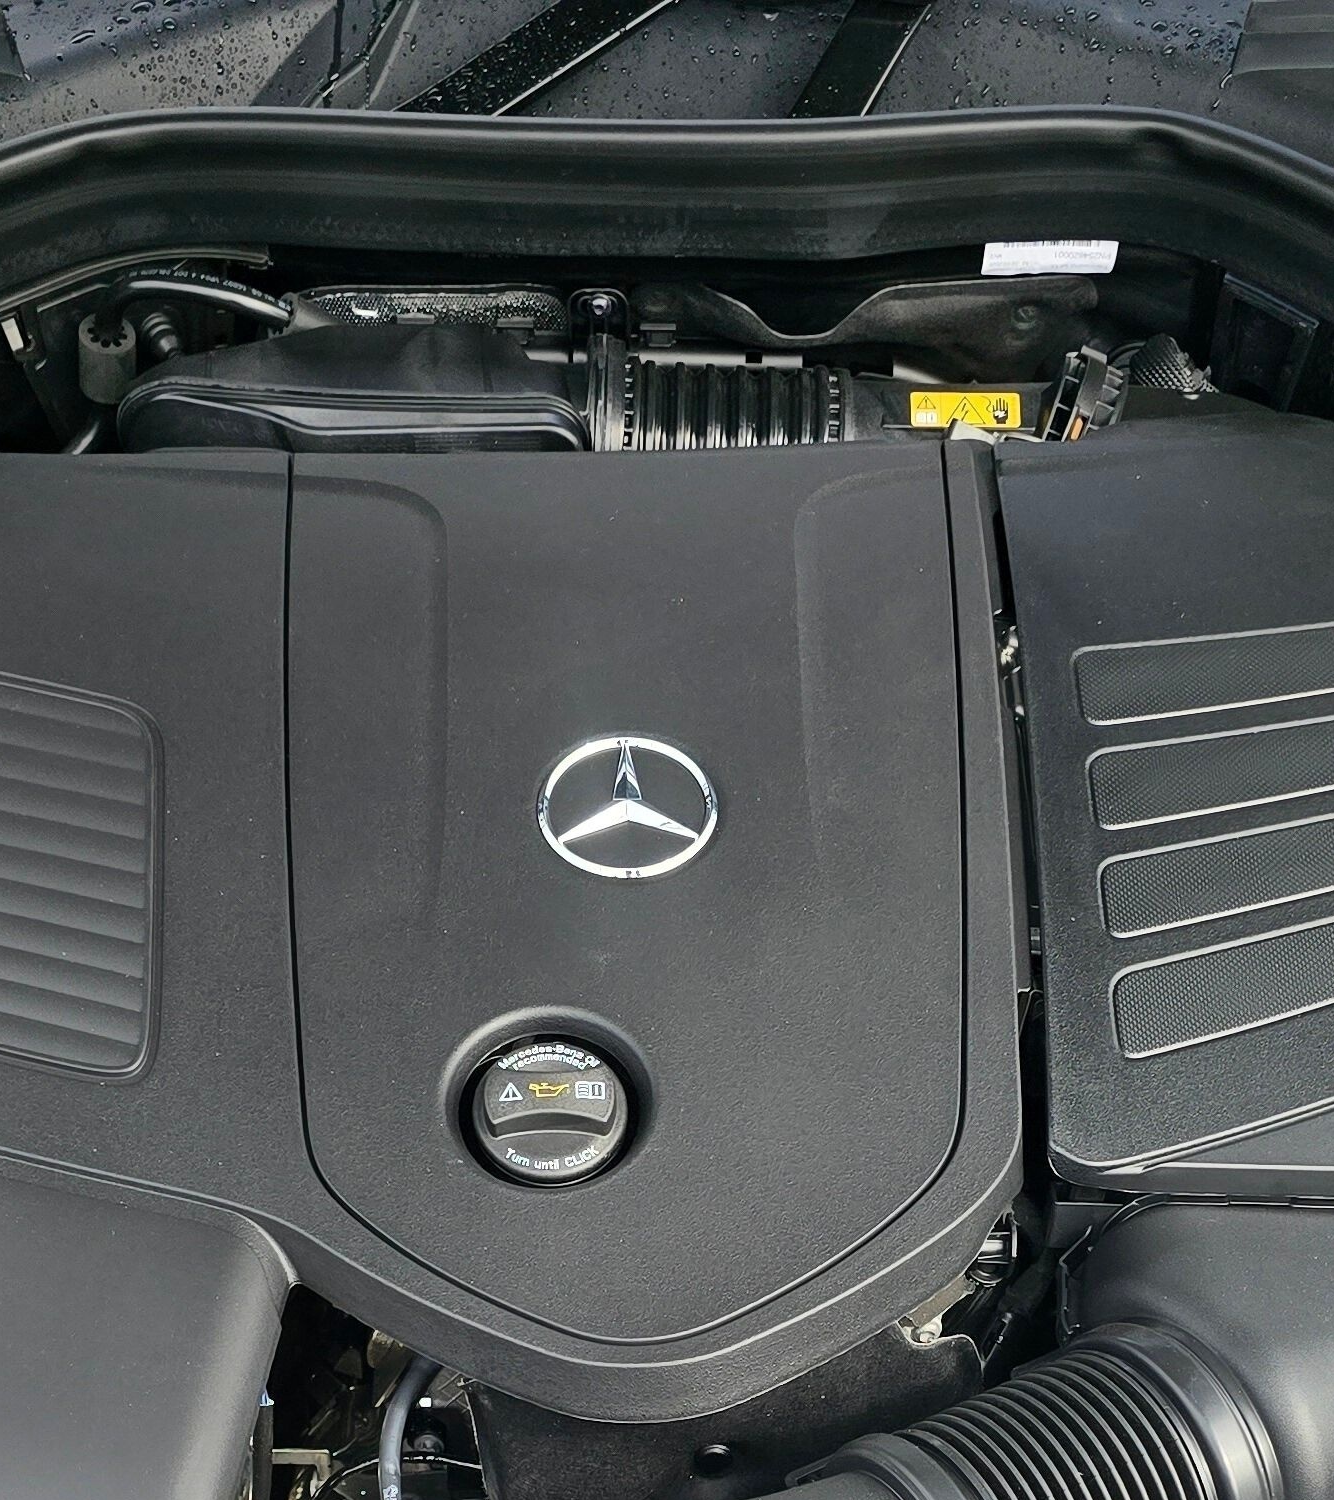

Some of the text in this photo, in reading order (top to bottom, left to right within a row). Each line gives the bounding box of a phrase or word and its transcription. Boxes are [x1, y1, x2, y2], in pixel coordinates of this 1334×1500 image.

[512, 1053, 588, 1071] recommended
[505, 1145, 599, 1170] Turn until CLICK
